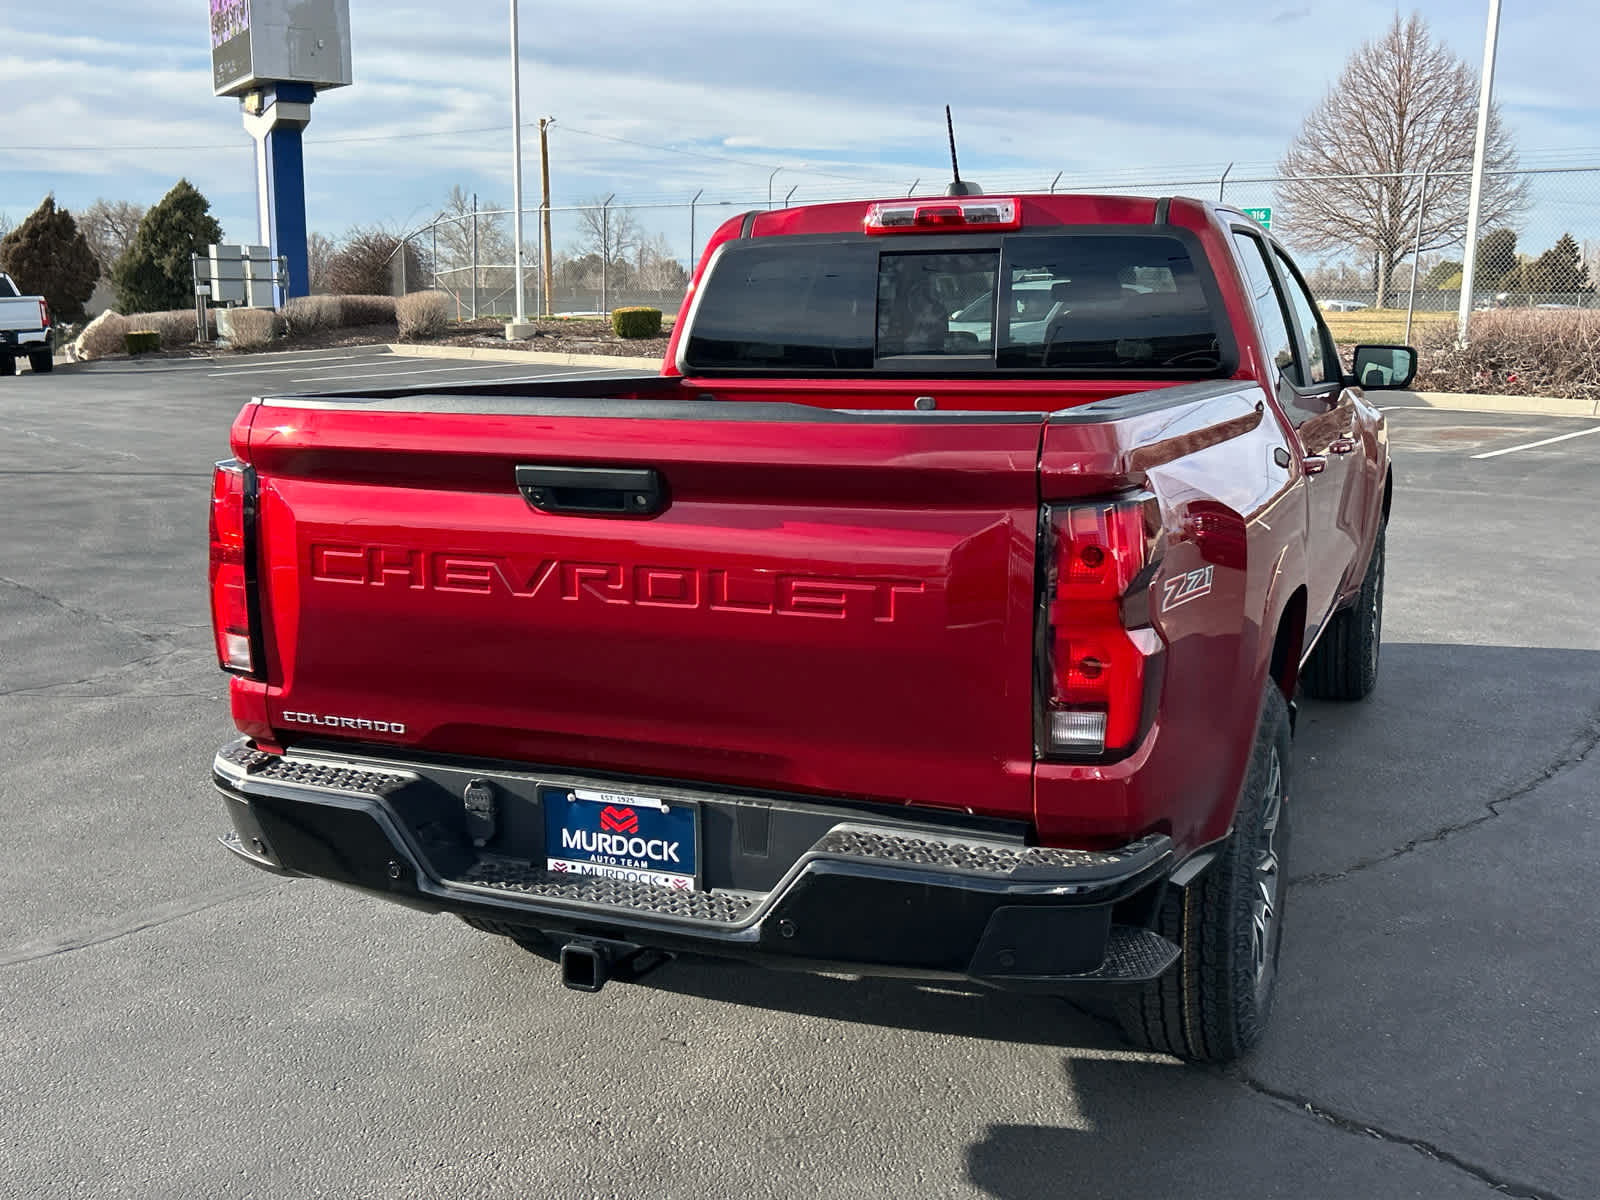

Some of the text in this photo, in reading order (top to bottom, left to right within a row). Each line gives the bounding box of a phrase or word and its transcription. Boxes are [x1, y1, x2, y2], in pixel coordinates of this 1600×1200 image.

[311, 543, 926, 623] CHEVROLET
[1162, 565, 1214, 613] Z71
[282, 711, 405, 734] COLORADO
[562, 828, 680, 863] MURDOCK
[580, 865, 662, 886] MURDOCK
[590, 854, 648, 868] AUTO TEAM
